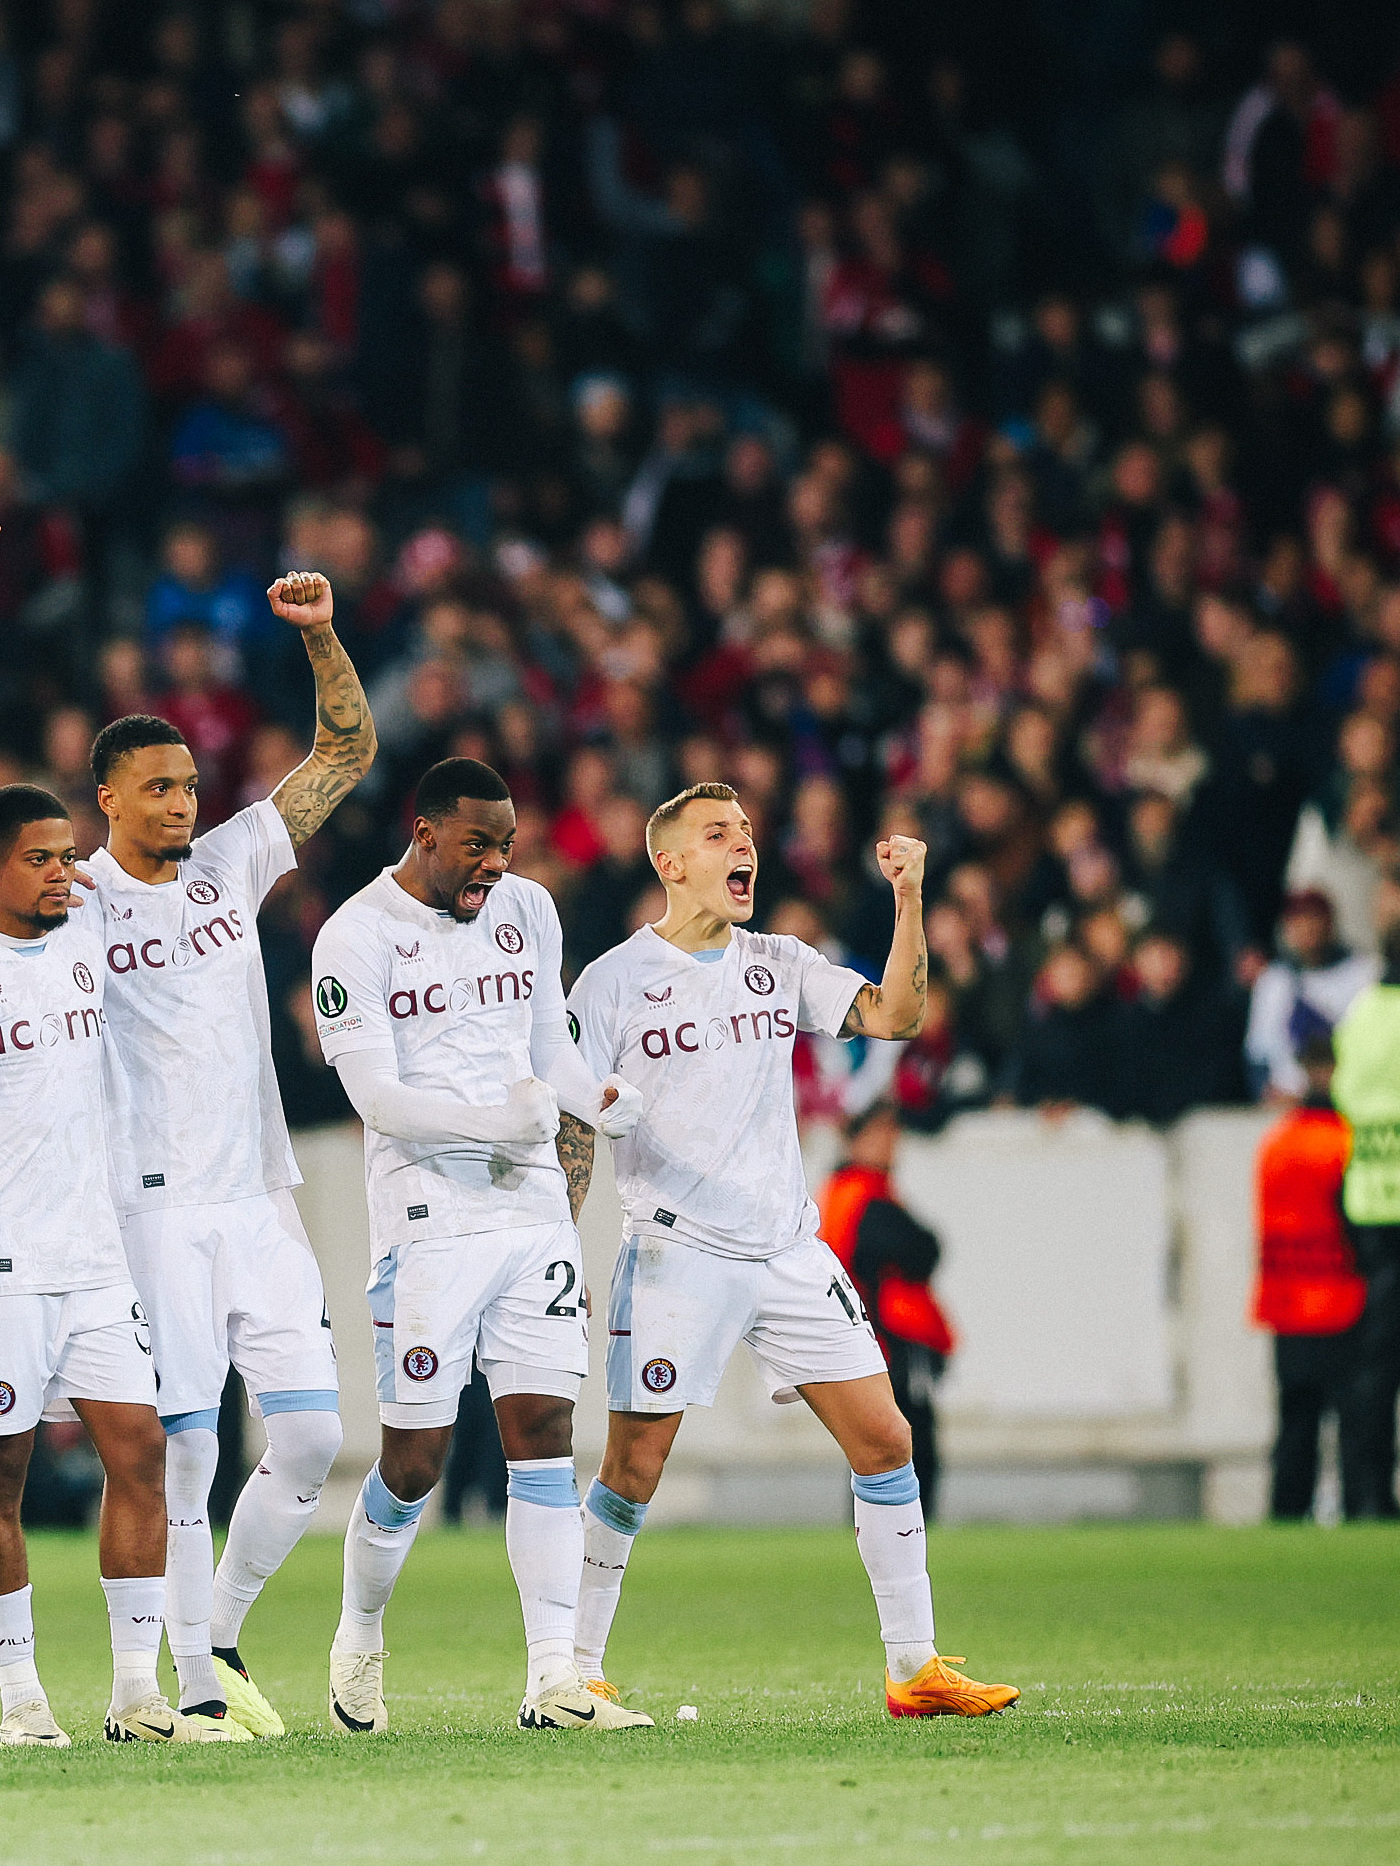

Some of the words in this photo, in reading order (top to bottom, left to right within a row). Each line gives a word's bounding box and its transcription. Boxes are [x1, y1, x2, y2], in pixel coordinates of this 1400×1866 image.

[107, 909, 244, 974] acorns
[388, 969, 535, 1019] acorns
[641, 1008, 795, 1059] acorns
[545, 1260, 587, 1317] 2
[583, 1555, 625, 1569] ILLA
